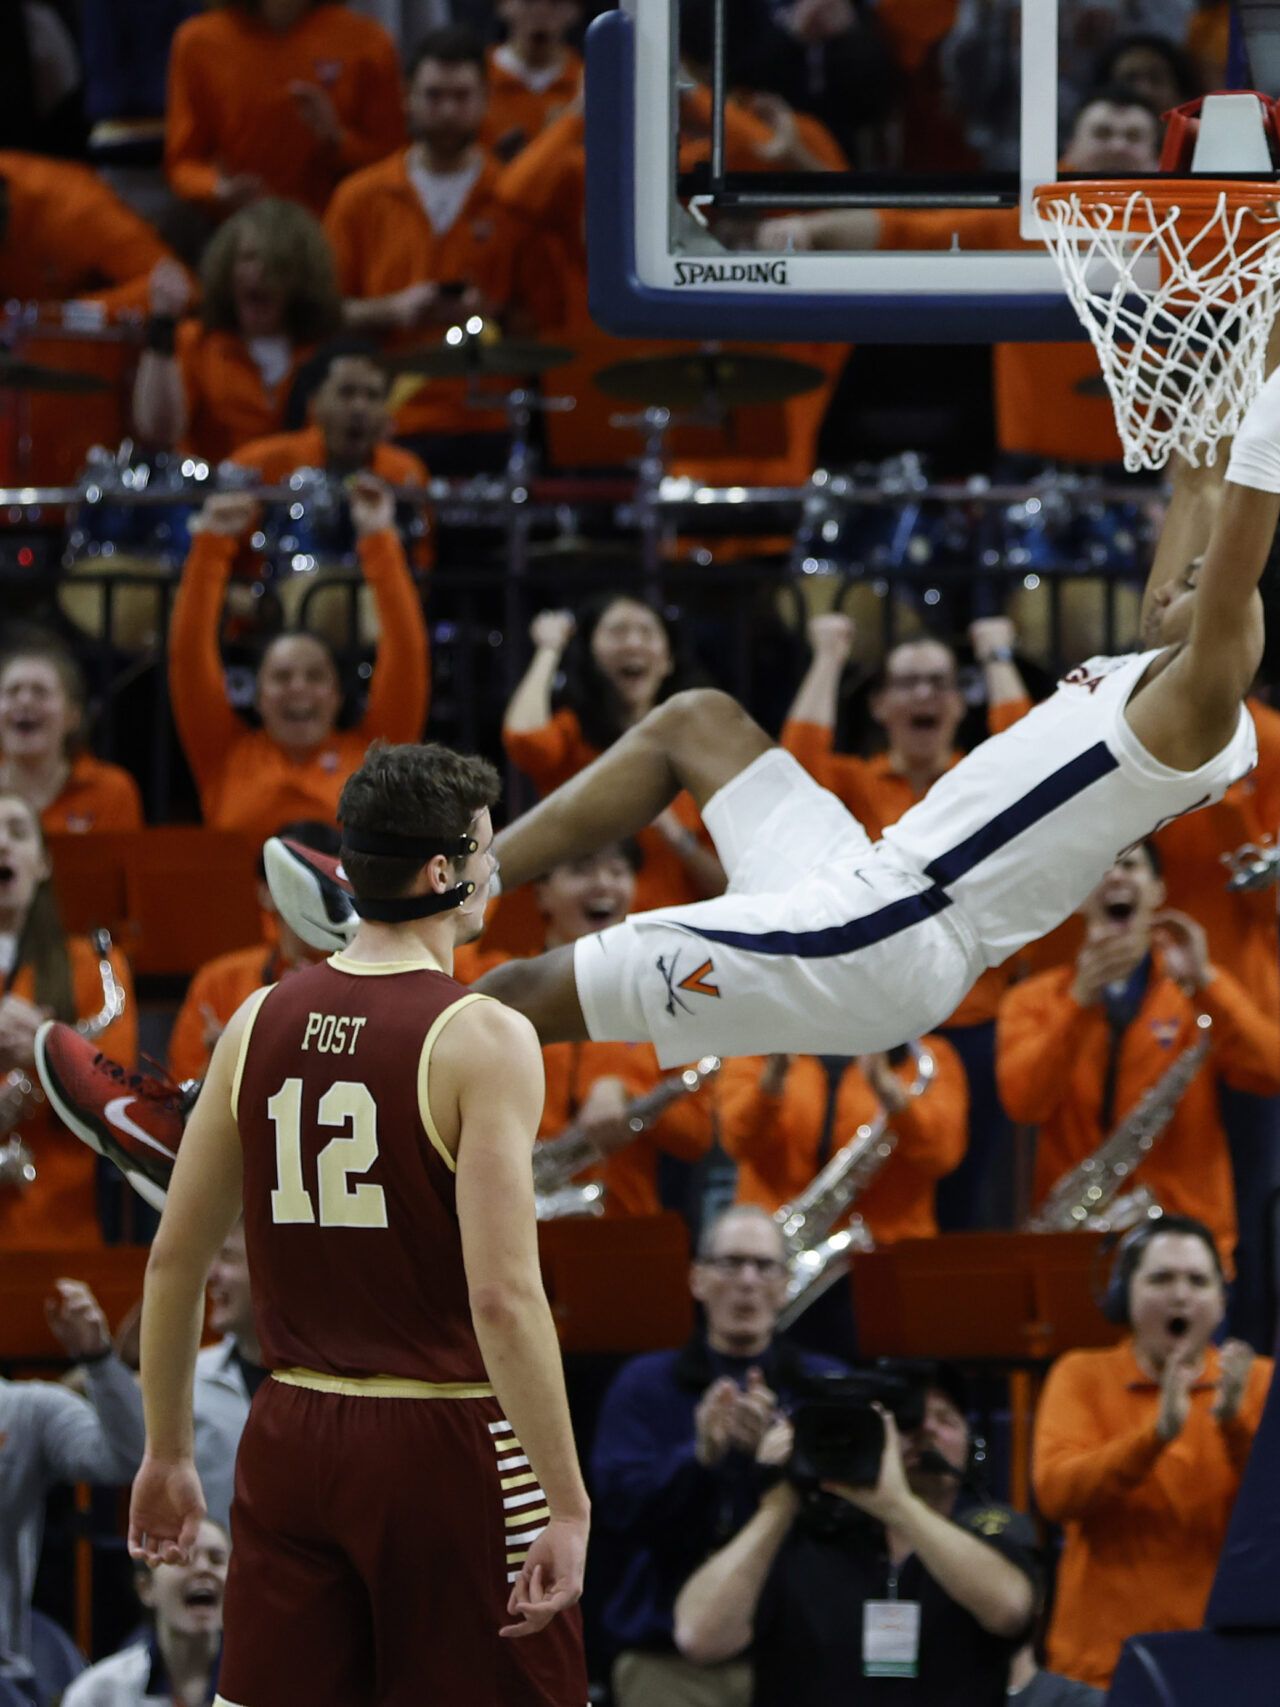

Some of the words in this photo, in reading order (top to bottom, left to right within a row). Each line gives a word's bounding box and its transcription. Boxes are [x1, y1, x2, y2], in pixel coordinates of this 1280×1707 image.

[674, 261, 787, 286] SPALDING
[301, 1012, 367, 1055] POST
[267, 1077, 388, 1228] 12
